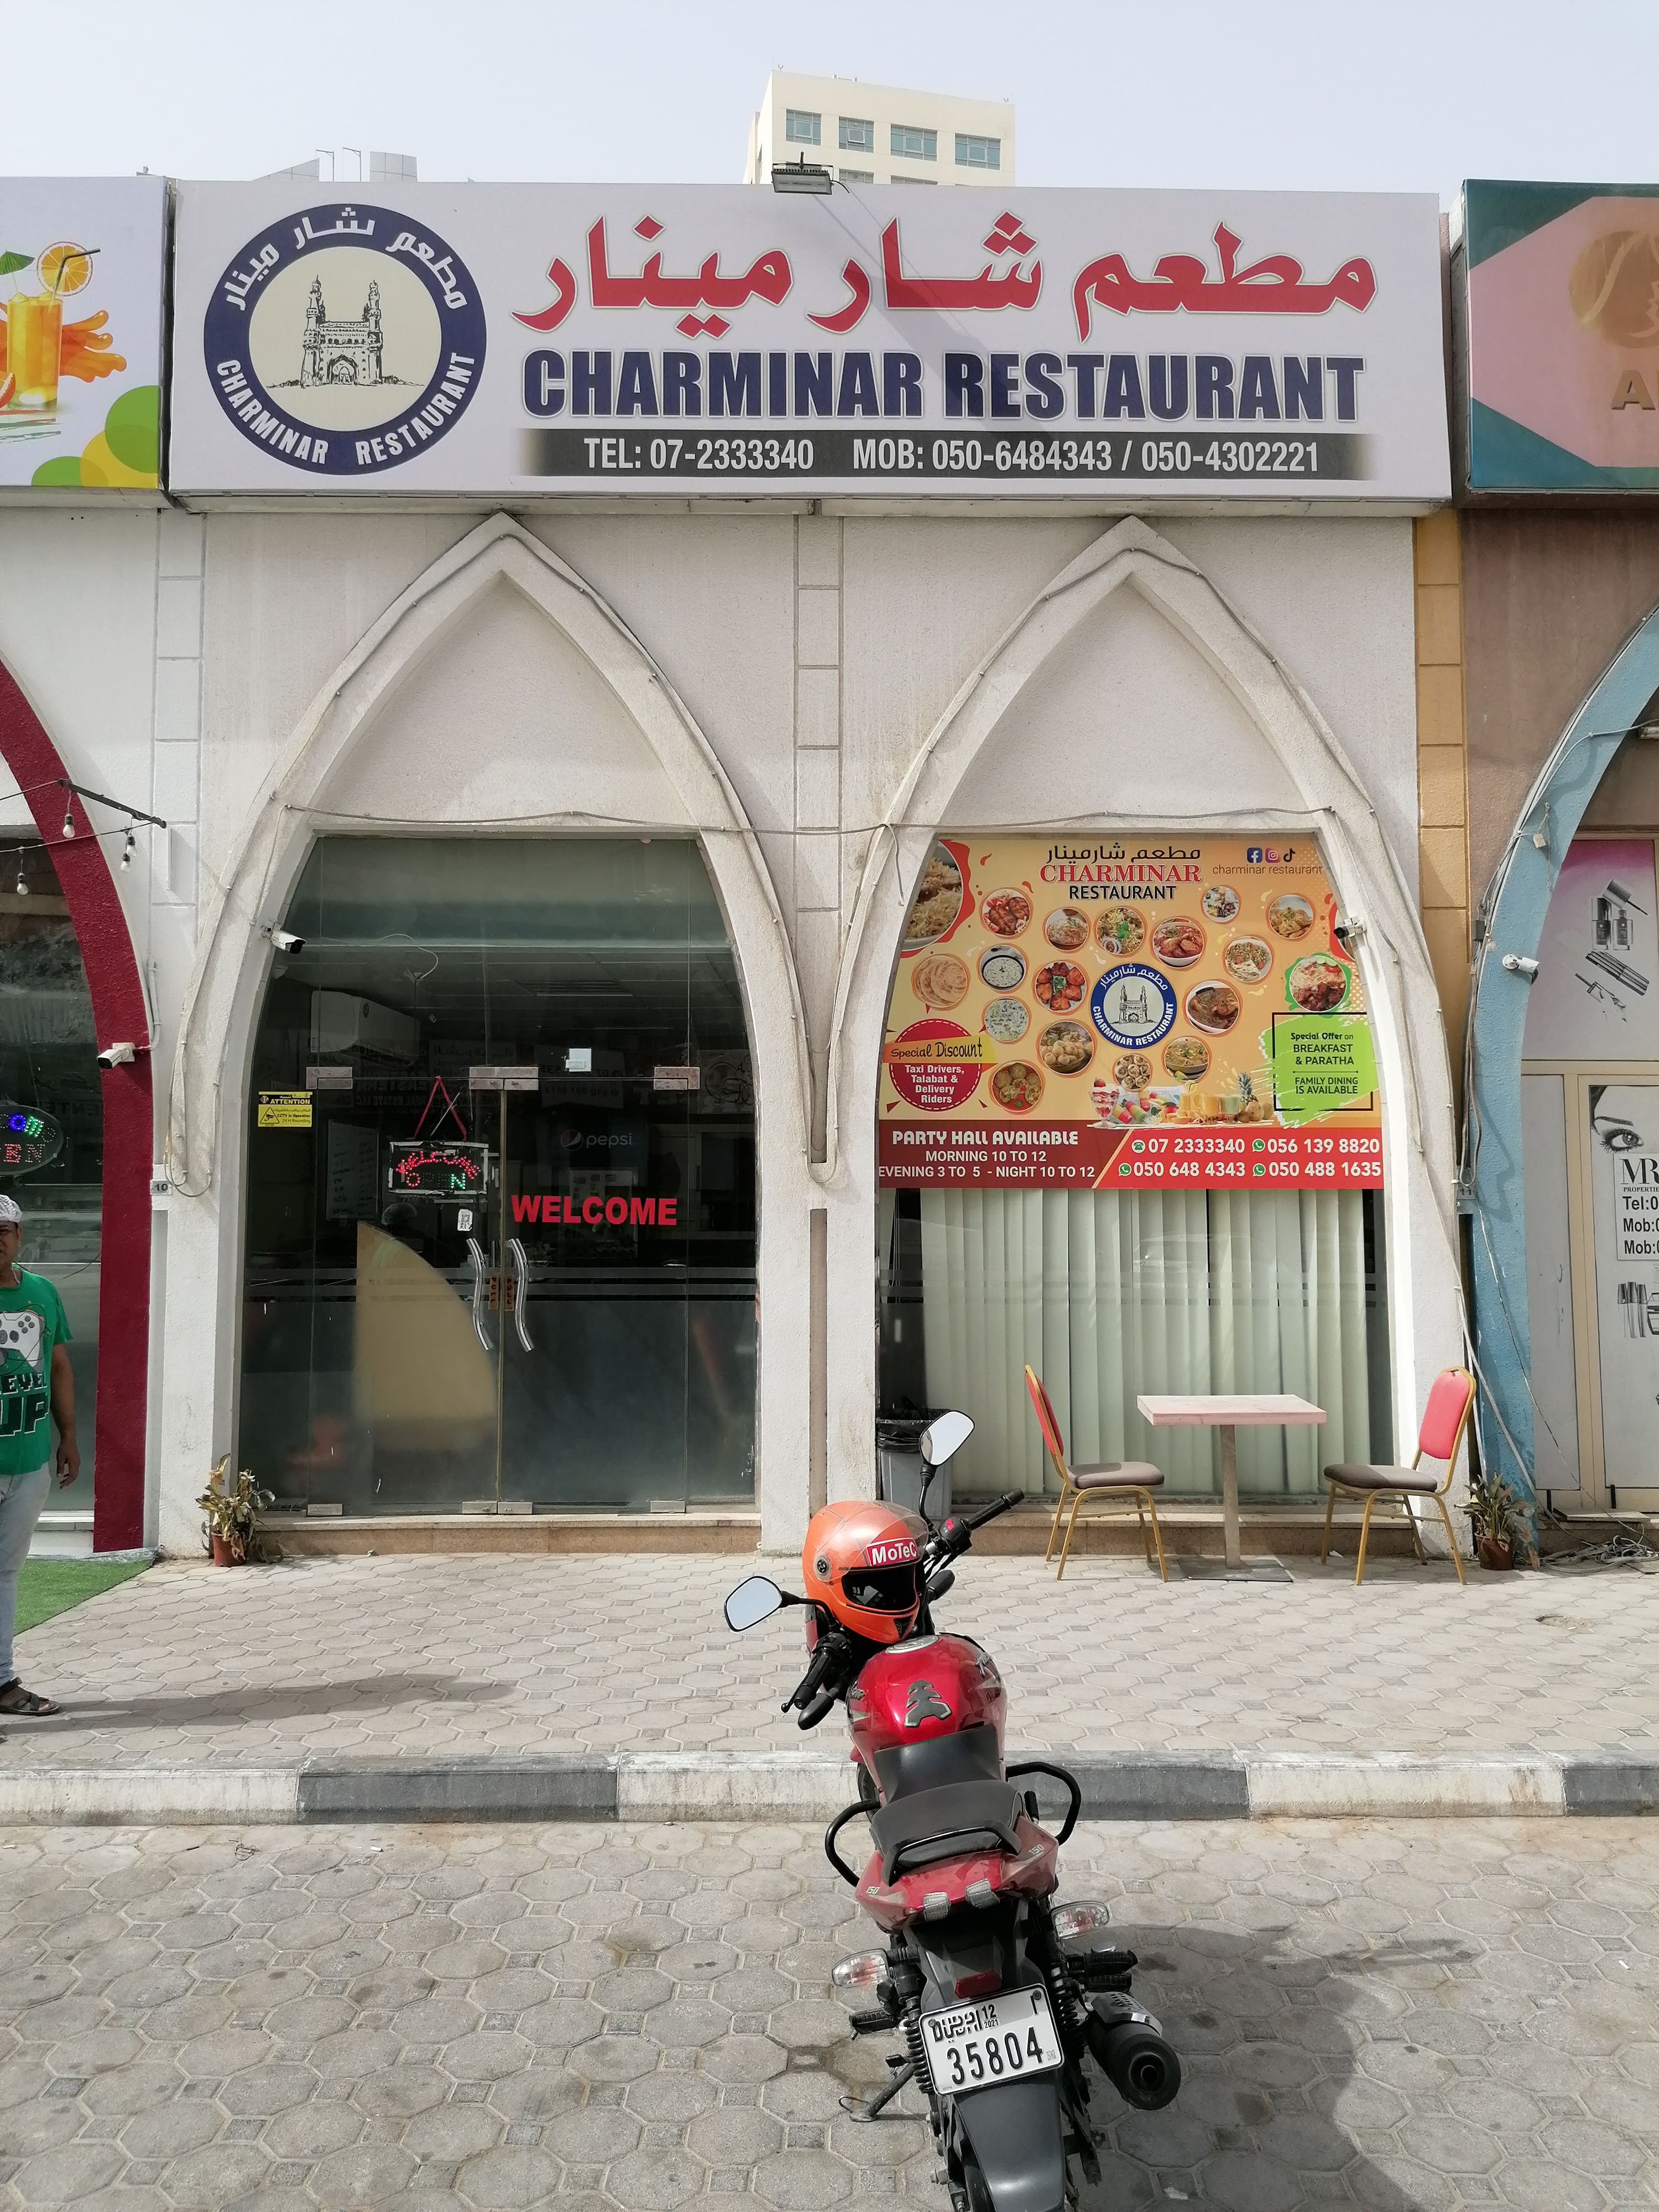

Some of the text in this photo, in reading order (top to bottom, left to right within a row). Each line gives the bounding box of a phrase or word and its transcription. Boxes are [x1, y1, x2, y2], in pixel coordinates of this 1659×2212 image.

[225, 207, 468, 311] مطعم شار مينار
[510, 210, 1378, 344] مطعم شار مينار
[523, 349, 1366, 421] CHARMINAR RESTAURANT
[1610, 369, 1659, 411] A
[216, 352, 476, 465] CHARMINAR RESTAURANT
[584, 437, 1319, 472] TEL: 07-2333340 MOB: 050-6484343 / 050-4302221
[1130, 845, 1201, 865] مطعم
[1040, 864, 1202, 883] CHARMINAR
[1212, 865, 1322, 875] charminar restaurant
[1069, 885, 1177, 900] RESTAURANT
[1093, 1003, 1174, 1046] CHARMINAR RESTAURANT
[1291, 1032, 1321, 1041] Special
[890, 1037, 983, 1060] Special Discount
[1293, 1044, 1353, 1053] BREAKFAST
[1295, 1056, 1354, 1065] & PARATHA
[905, 1065, 964, 1074] Taxi Drivers,
[911, 1074, 958, 1084] Talabat &
[1295, 1077, 1358, 1085] FAMILY DINING
[915, 1084, 954, 1095] Delivery
[1296, 1086, 1358, 1094] IS AVAILABLE
[921, 1095, 952, 1103] Riders
[586, 1132, 633, 1148] pepsi
[893, 1130, 1078, 1145] PARTY HALL AVAILABLE
[1148, 1138, 1245, 1154] 07 2333340
[1267, 1138, 1380, 1154] 056 139 8820
[925, 1151, 1046, 1162] MORNING 10 TO 12
[878, 1166, 934, 1177] EVENING
[937, 1166, 945, 1177] 3
[948, 1166, 966, 1177] TO
[973, 1166, 980, 1177] 5
[996, 1166, 1036, 1177] NIGHT
[1040, 1166, 1055, 1177] 10
[1058, 1166, 1076, 1177] TO
[1079, 1166, 1095, 1178] 12
[1134, 1162, 1246, 1177] 050 648 4343
[1269, 1162, 1381, 1177] 050 488 1635
[154, 1183, 169, 1191] 10
[511, 1195, 677, 1226] WELCOME
[1623, 1196, 1658, 1210] Tel:0
[1624, 1240, 1659, 1254] Mob:
[0, 1392, 50, 1437] UP
[872, 1541, 918, 1566] MoTeC
[1029, 1844, 1045, 1855] 150
[981, 2004, 997, 2020] 12
[984, 2018, 999, 2028] 2021
[946, 2026, 1044, 2085] 35804
